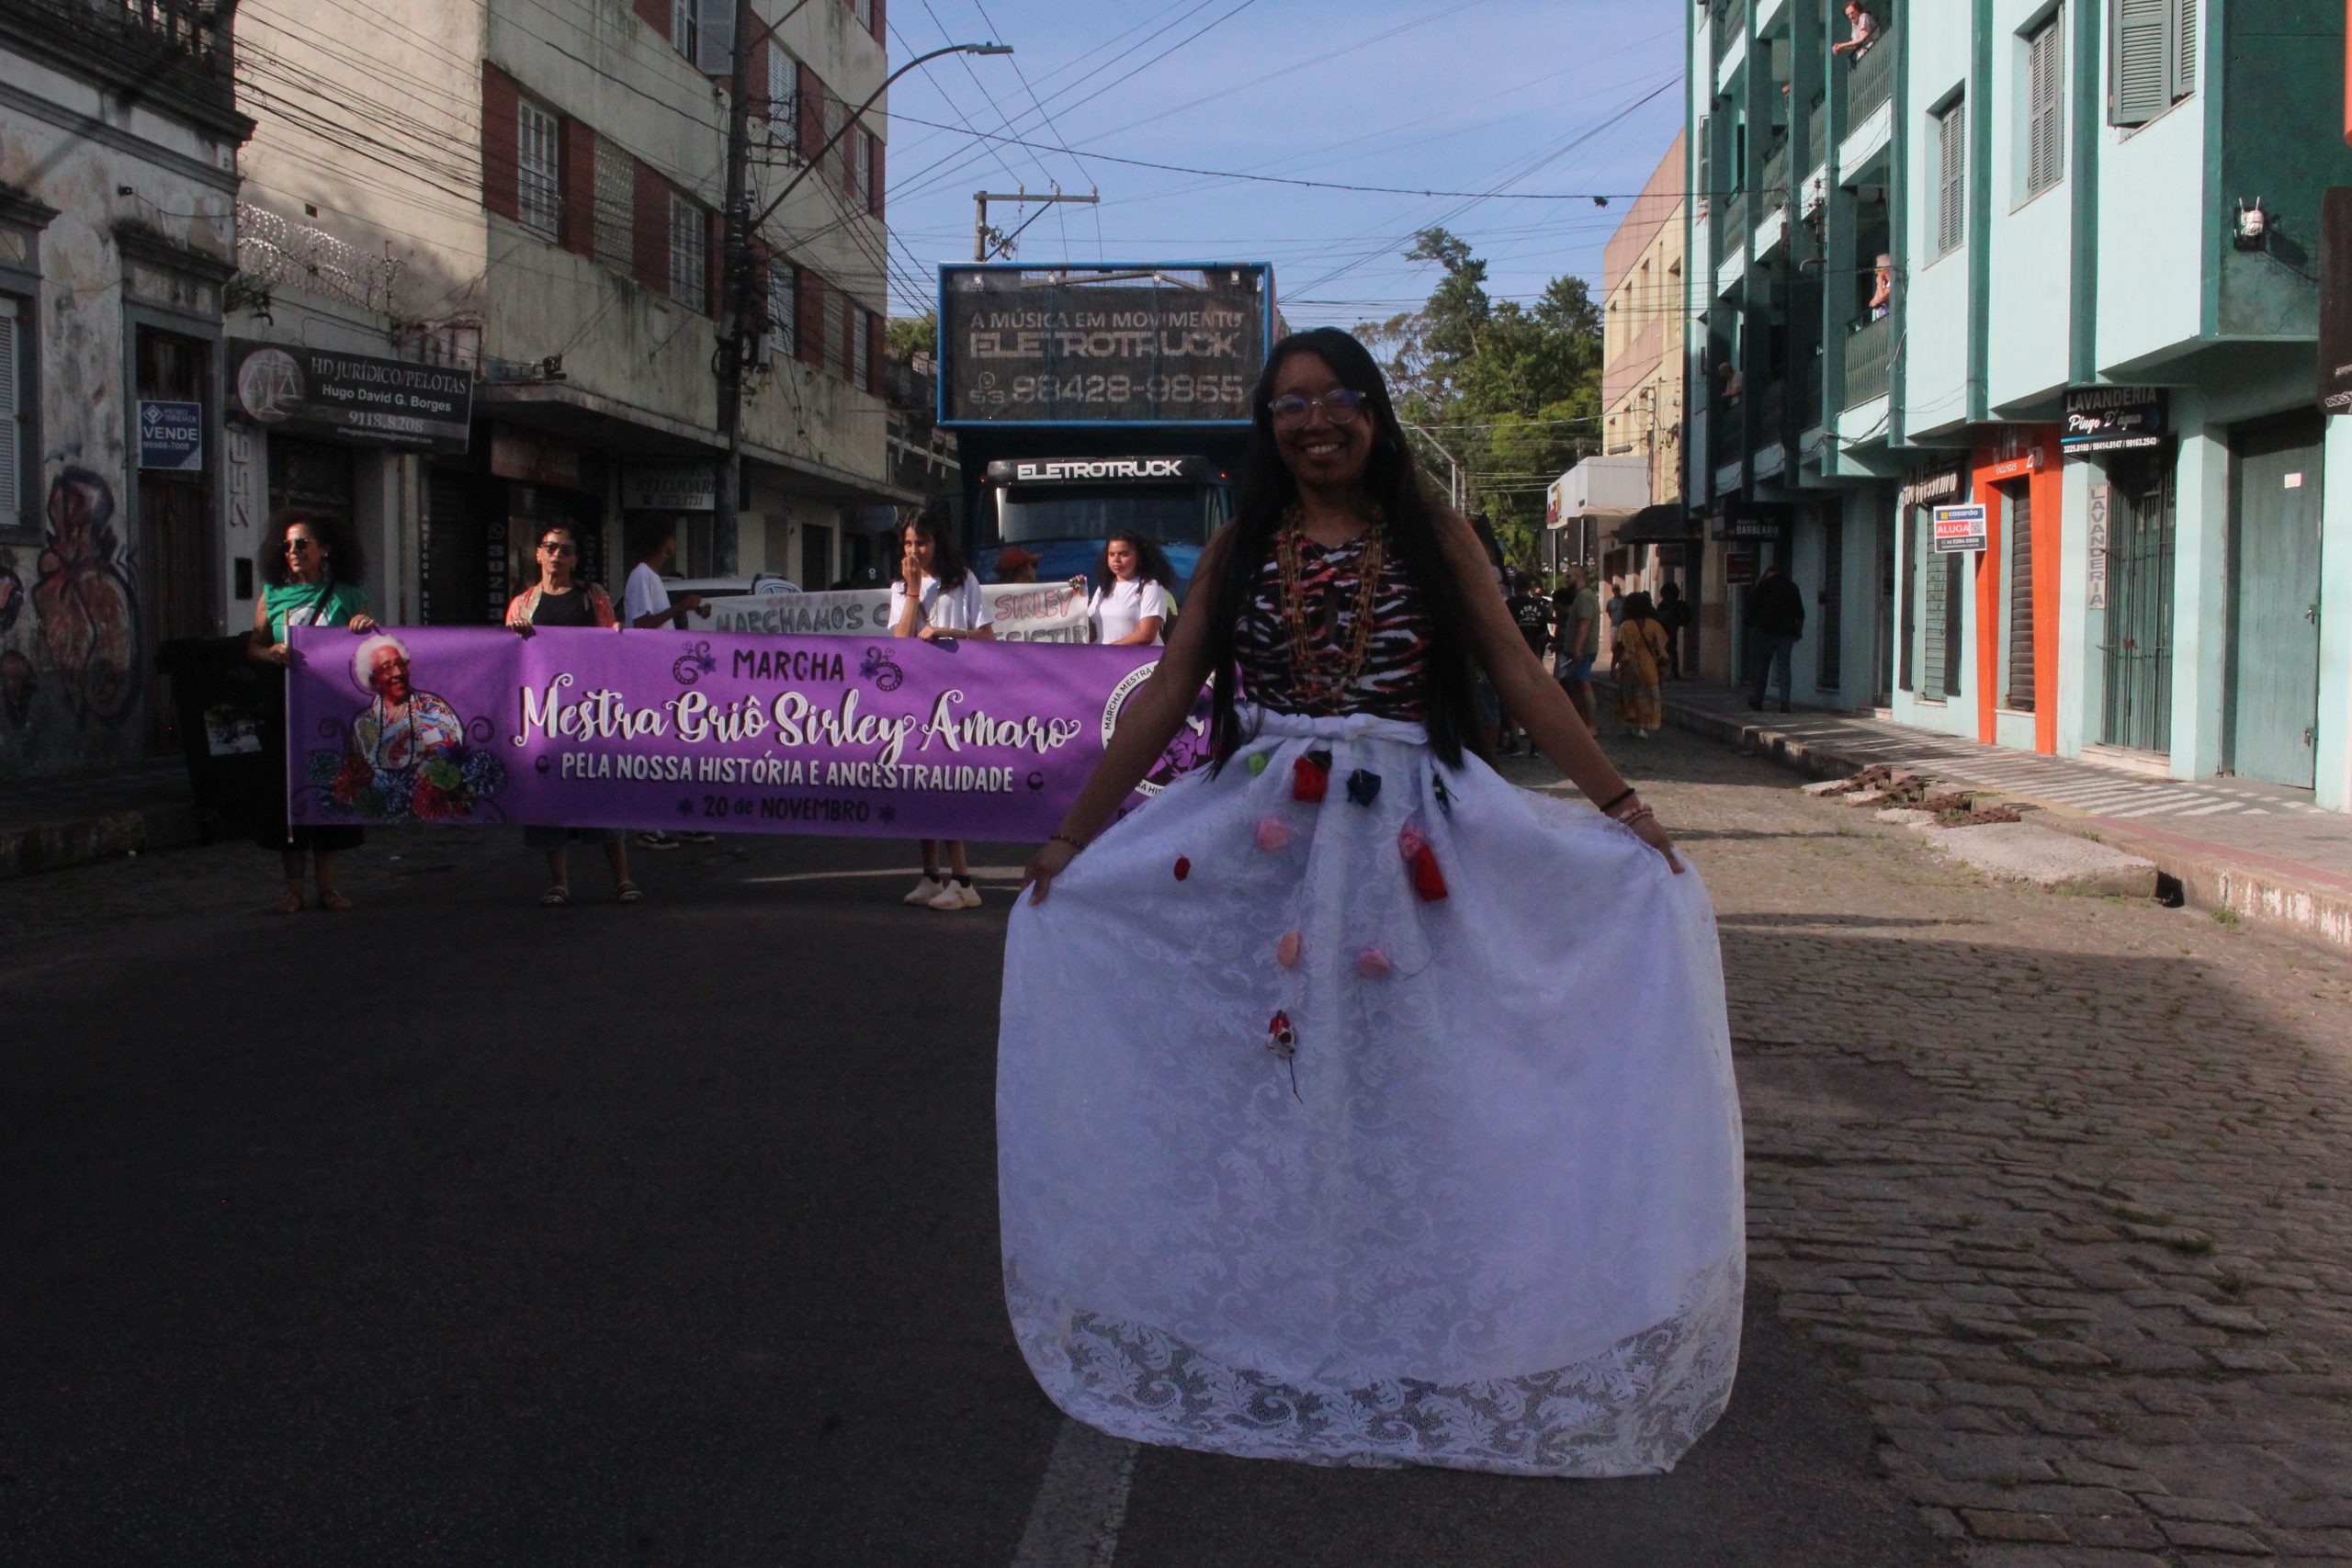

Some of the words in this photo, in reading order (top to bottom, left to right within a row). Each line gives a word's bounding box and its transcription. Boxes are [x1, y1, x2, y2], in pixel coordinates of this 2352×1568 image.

[970, 312, 985, 329] A
[990, 307, 1069, 329] MÚSICA
[1075, 312, 1106, 329] EM
[1113, 311, 1244, 329] MOVIMENTO
[969, 331, 1242, 359] ELETROTRUCK
[311, 356, 334, 375] HD
[322, 383, 356, 400] Hugo
[357, 389, 391, 403] David
[394, 393, 407, 406] G.
[410, 395, 453, 412] Borges
[1012, 373, 1244, 404] 98428-9855
[2066, 387, 2157, 412] LAVANDERIA
[142, 425, 198, 442] VENDE
[348, 411, 424, 434] 9118.8208
[2068, 413, 2100, 434] Pingo
[1017, 459, 1183, 480] ELETROTRUCK
[1937, 524, 1969, 535] ALUGA
[2088, 489, 2105, 606] LAVANDERIA
[994, 588, 1074, 620] SIRLEY
[732, 649, 844, 682] MARCHA
[1104, 692, 1123, 730] MARCHA
[1121, 667, 1153, 694] MESTRA
[511, 672, 670, 748] Mestra
[665, 691, 770, 743] Griô
[774, 688, 917, 768] Sirley
[919, 689, 1081, 754] Amaro
[561, 751, 610, 780] PELA
[616, 753, 693, 782] NOSSA
[699, 750, 803, 785] HISTÓRIA
[808, 760, 820, 786] E
[825, 761, 1014, 793] ANCESTRALIDADE
[703, 795, 729, 818] 20
[734, 796, 753, 816] de
[760, 796, 870, 823] NOVEMBRO
